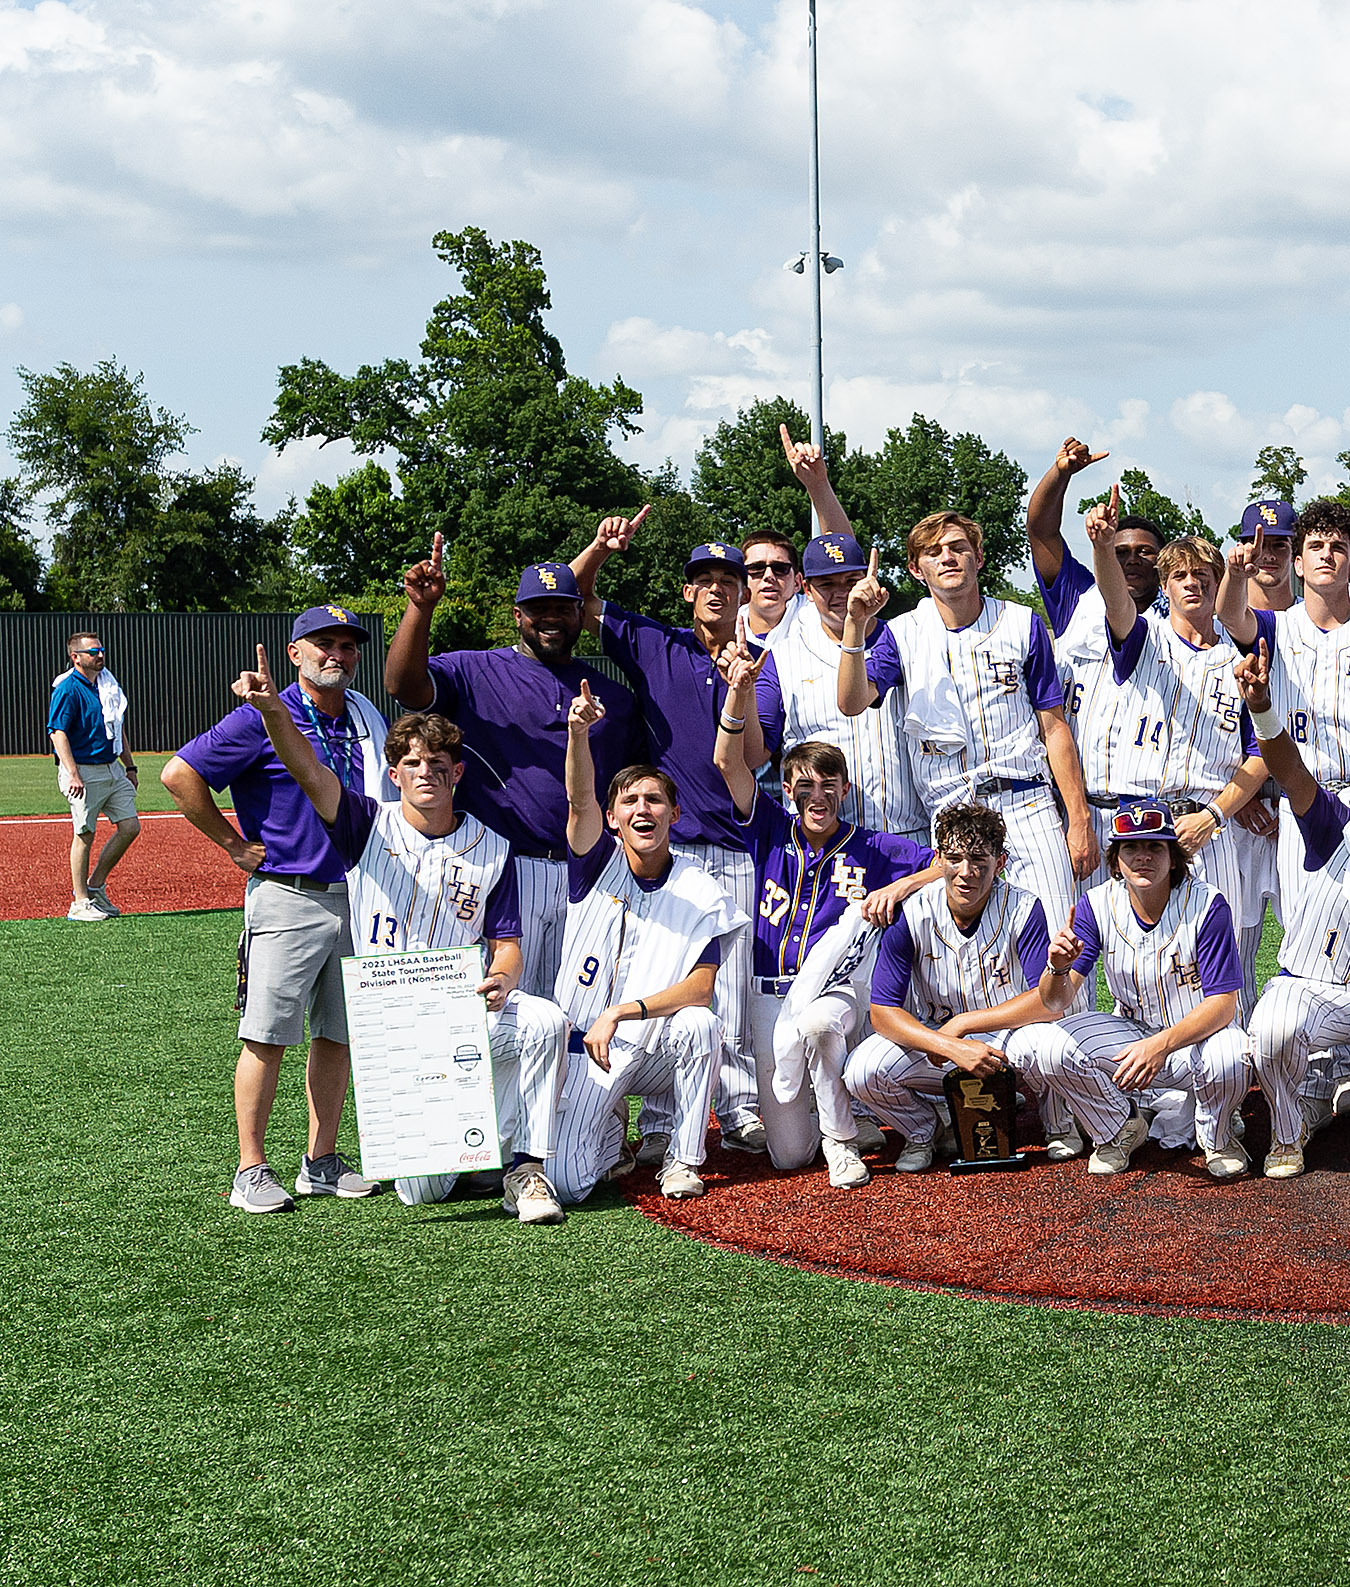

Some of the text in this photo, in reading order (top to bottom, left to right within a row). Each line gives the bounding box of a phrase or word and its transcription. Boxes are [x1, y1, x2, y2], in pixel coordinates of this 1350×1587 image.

[1063, 678, 1085, 716] 16
[1133, 714, 1164, 751] 14
[759, 877, 791, 927] 37
[368, 910, 399, 949] 13
[1322, 929, 1341, 960] 1
[362, 953, 462, 970] 2023 LHSAA Baseball
[371, 963, 454, 978] State Tournament
[577, 954, 601, 988] 9
[360, 979, 398, 989] Division
[408, 972, 467, 985] (Non-Select)
